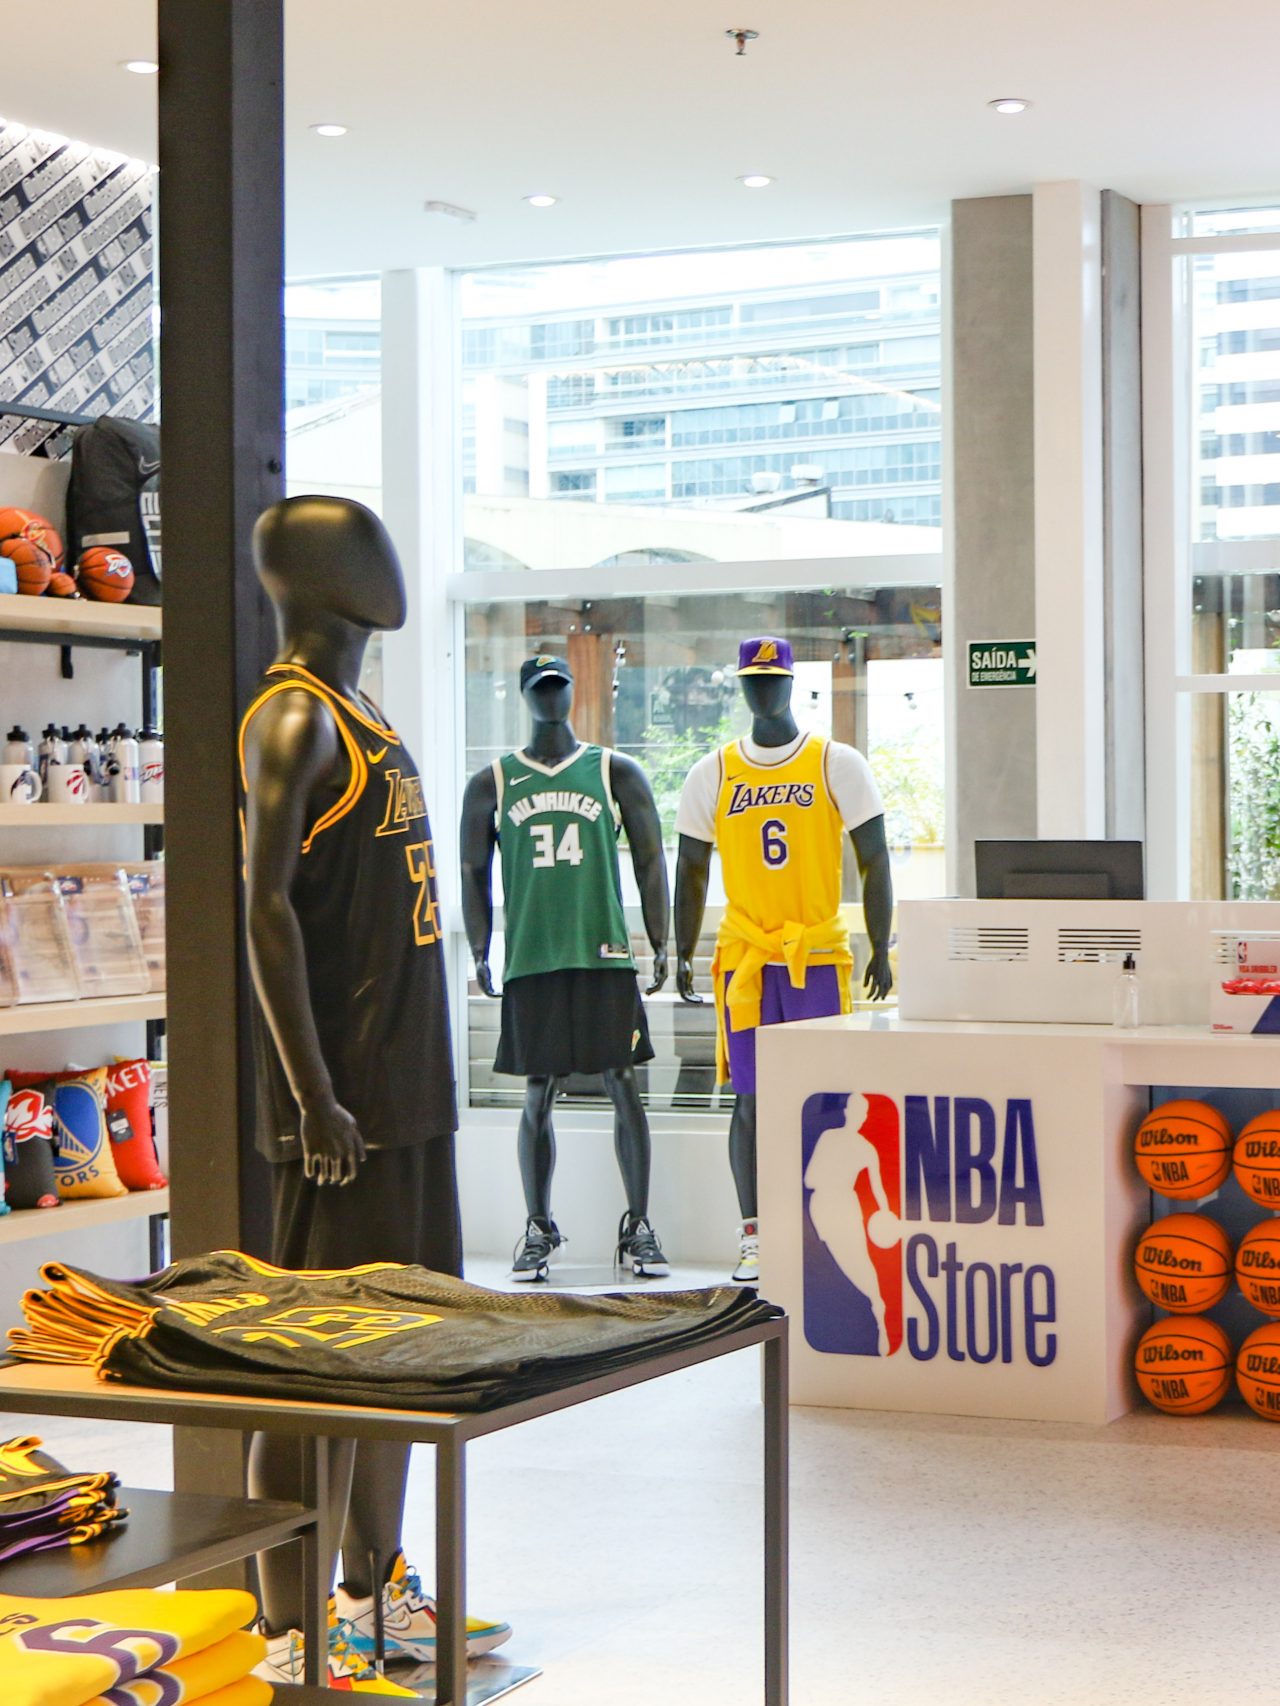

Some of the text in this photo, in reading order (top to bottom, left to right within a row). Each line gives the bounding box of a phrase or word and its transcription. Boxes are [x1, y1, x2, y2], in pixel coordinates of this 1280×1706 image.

[972, 646, 1017, 669] SAÍDA
[507, 791, 602, 827] MILWAUKEE
[726, 782, 815, 817] LAKERS
[530, 822, 584, 869] 34
[761, 819, 788, 870] 6
[105, 1061, 151, 1098] KET
[1141, 1128, 1198, 1146] Wilson
[904, 1095, 1044, 1227] NBA
[1162, 1161, 1190, 1182] NBA
[56, 1165, 99, 1187] ORS
[1143, 1246, 1202, 1271] Wilson
[906, 1233, 1057, 1367] Store
[1160, 1283, 1187, 1303] NBA
[1143, 1345, 1204, 1363] Wilson
[1161, 1379, 1190, 1400] NBA
